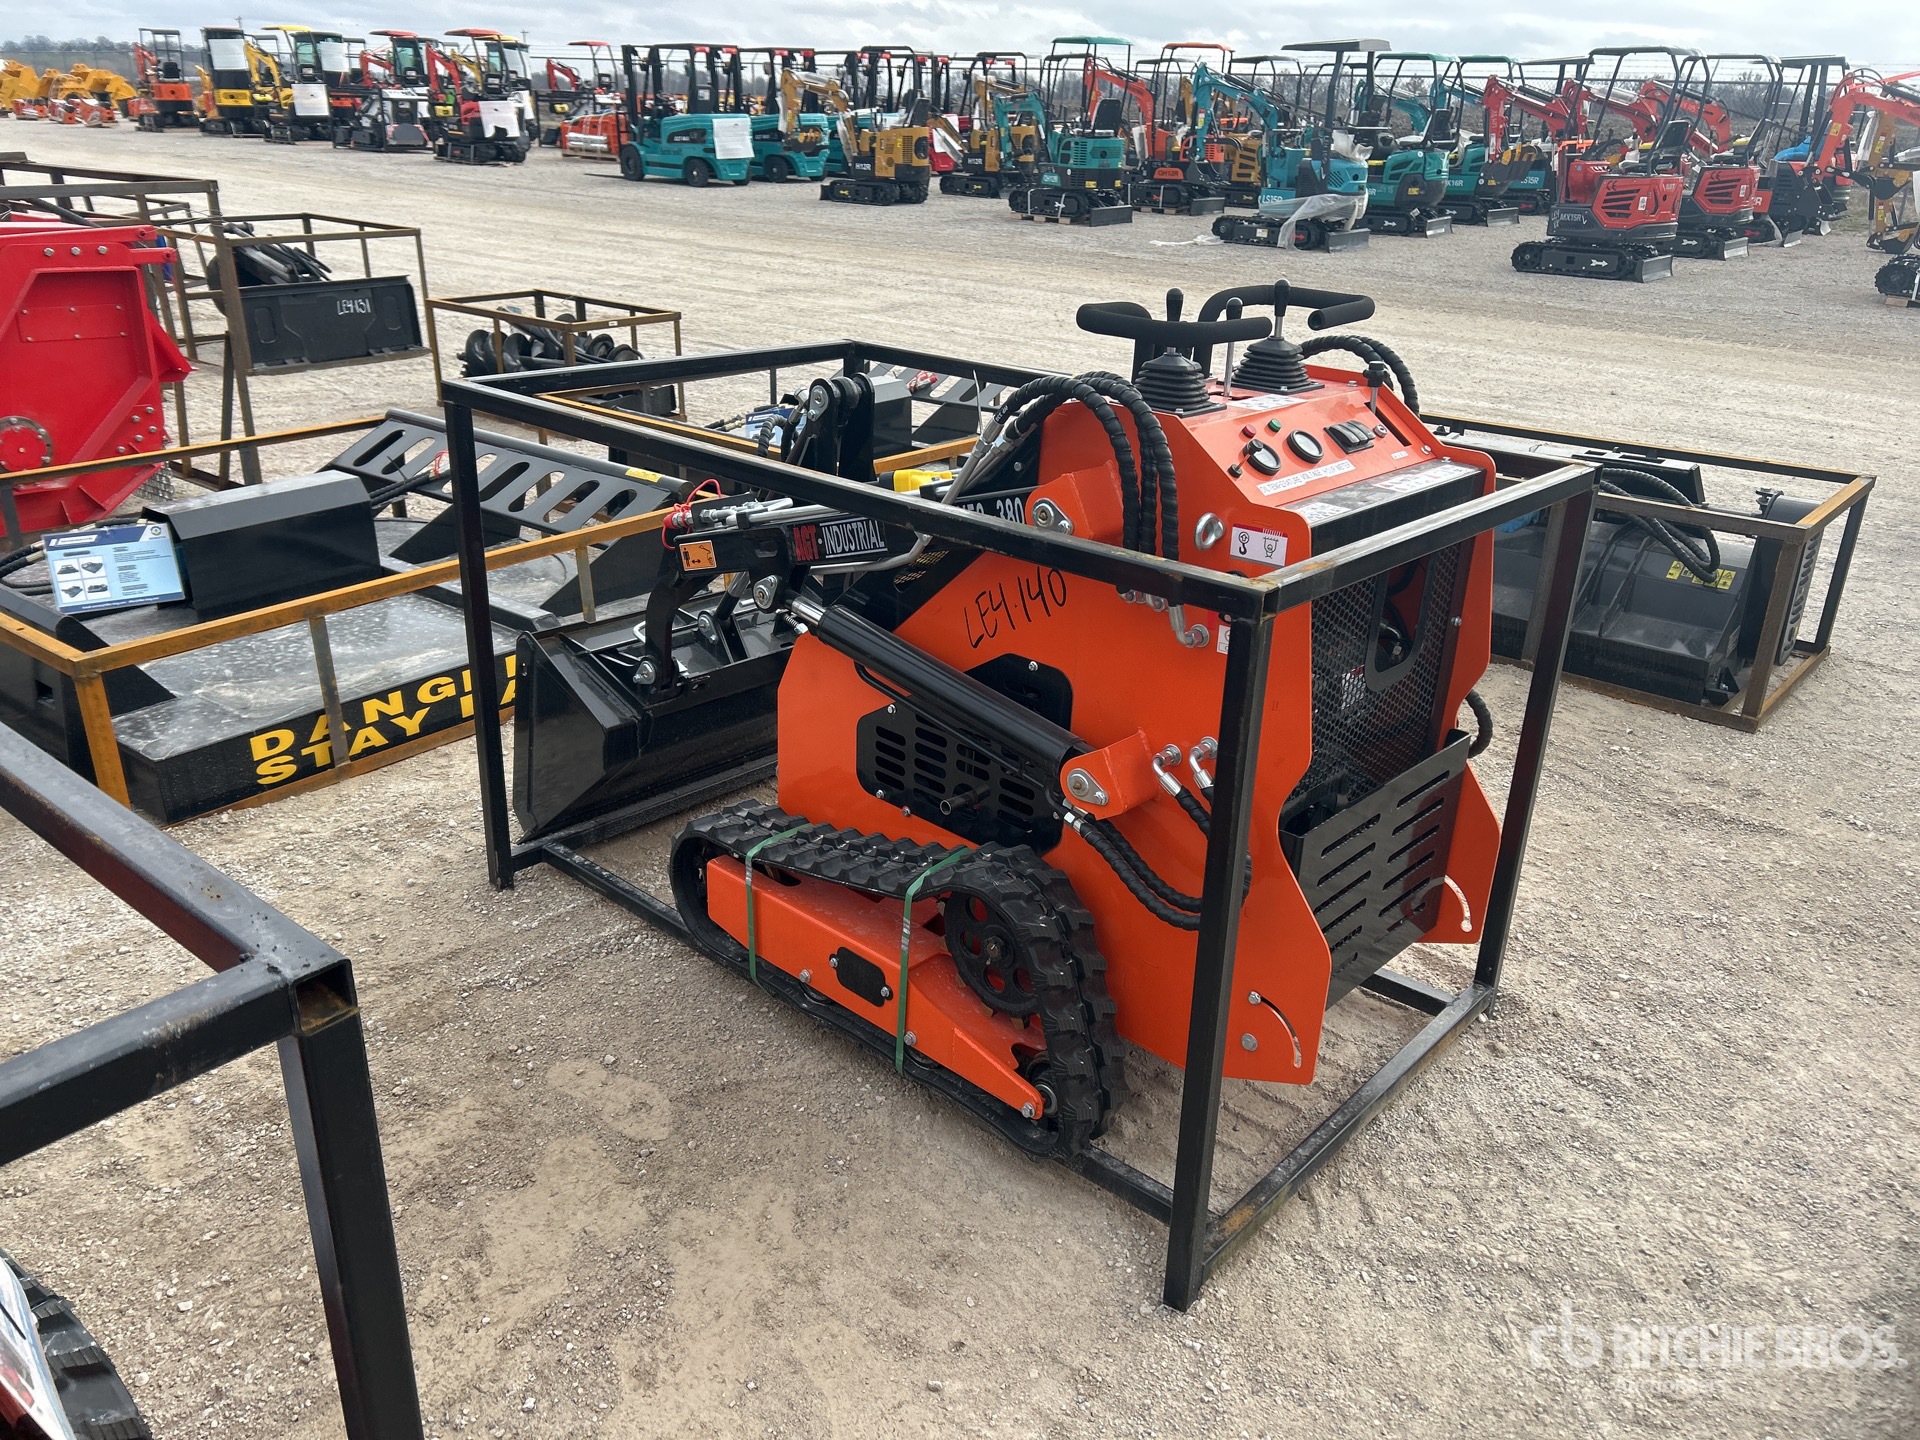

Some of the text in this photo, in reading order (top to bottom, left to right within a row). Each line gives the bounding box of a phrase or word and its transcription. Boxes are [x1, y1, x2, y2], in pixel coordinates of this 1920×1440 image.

[996, 497, 1026, 525] 380
[822, 519, 885, 555] INDUSTRIAL
[256, 706, 431, 785] STAY
